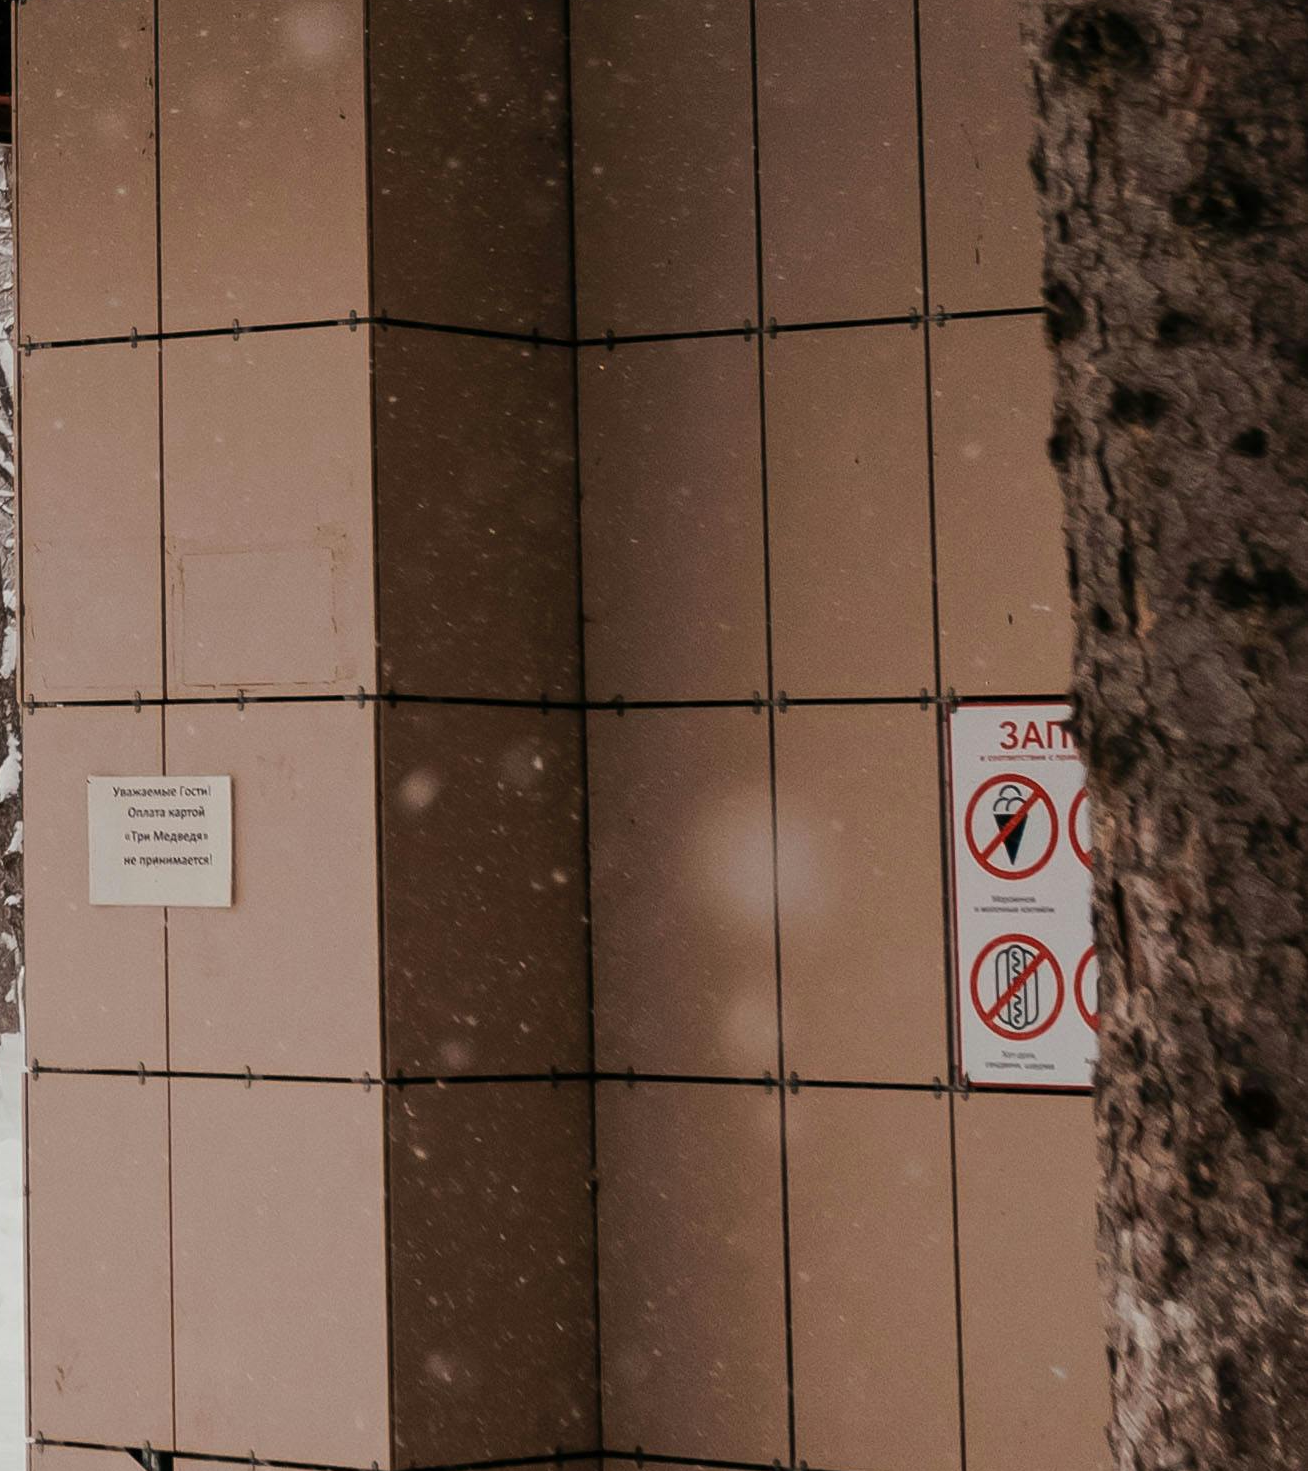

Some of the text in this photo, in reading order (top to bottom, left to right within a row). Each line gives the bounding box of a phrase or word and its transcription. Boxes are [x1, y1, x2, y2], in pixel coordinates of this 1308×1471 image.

[999, 720, 1076, 750] ЗАП
[112, 786, 177, 798] Уважаемые
[127, 806, 206, 820] Оплата картой
[124, 856, 137, 866] не
